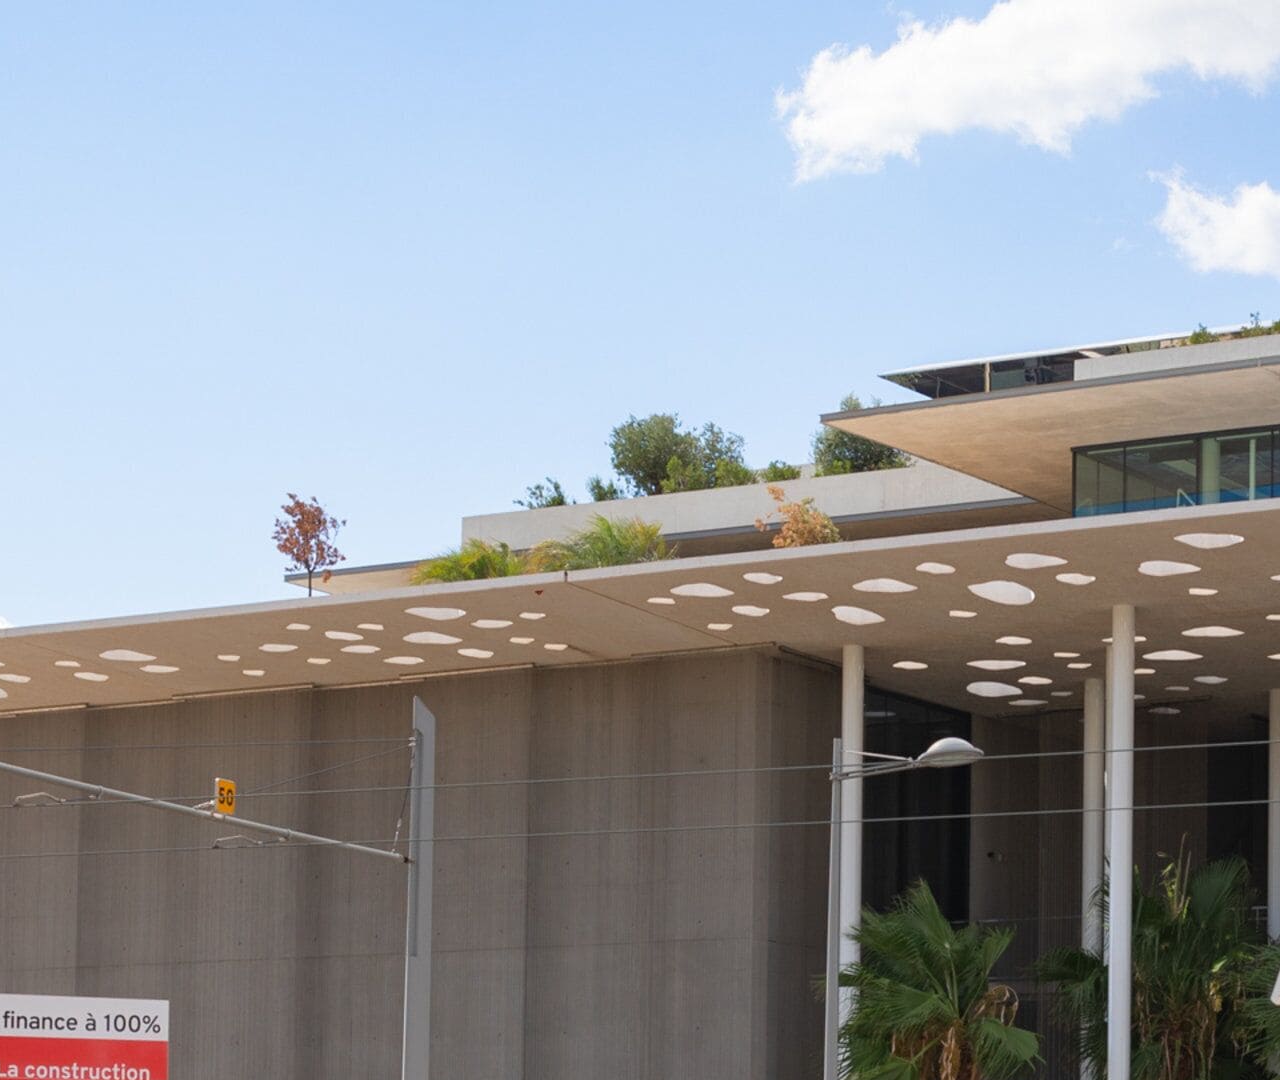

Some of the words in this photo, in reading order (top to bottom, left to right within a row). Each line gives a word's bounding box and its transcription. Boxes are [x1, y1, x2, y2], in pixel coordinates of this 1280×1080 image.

[218, 787, 234, 807] 50
[2, 1010, 78, 1031] finance
[84, 1012, 97, 1032] à
[104, 1014, 161, 1034] 100%
[24, 1062, 151, 1080] construction
